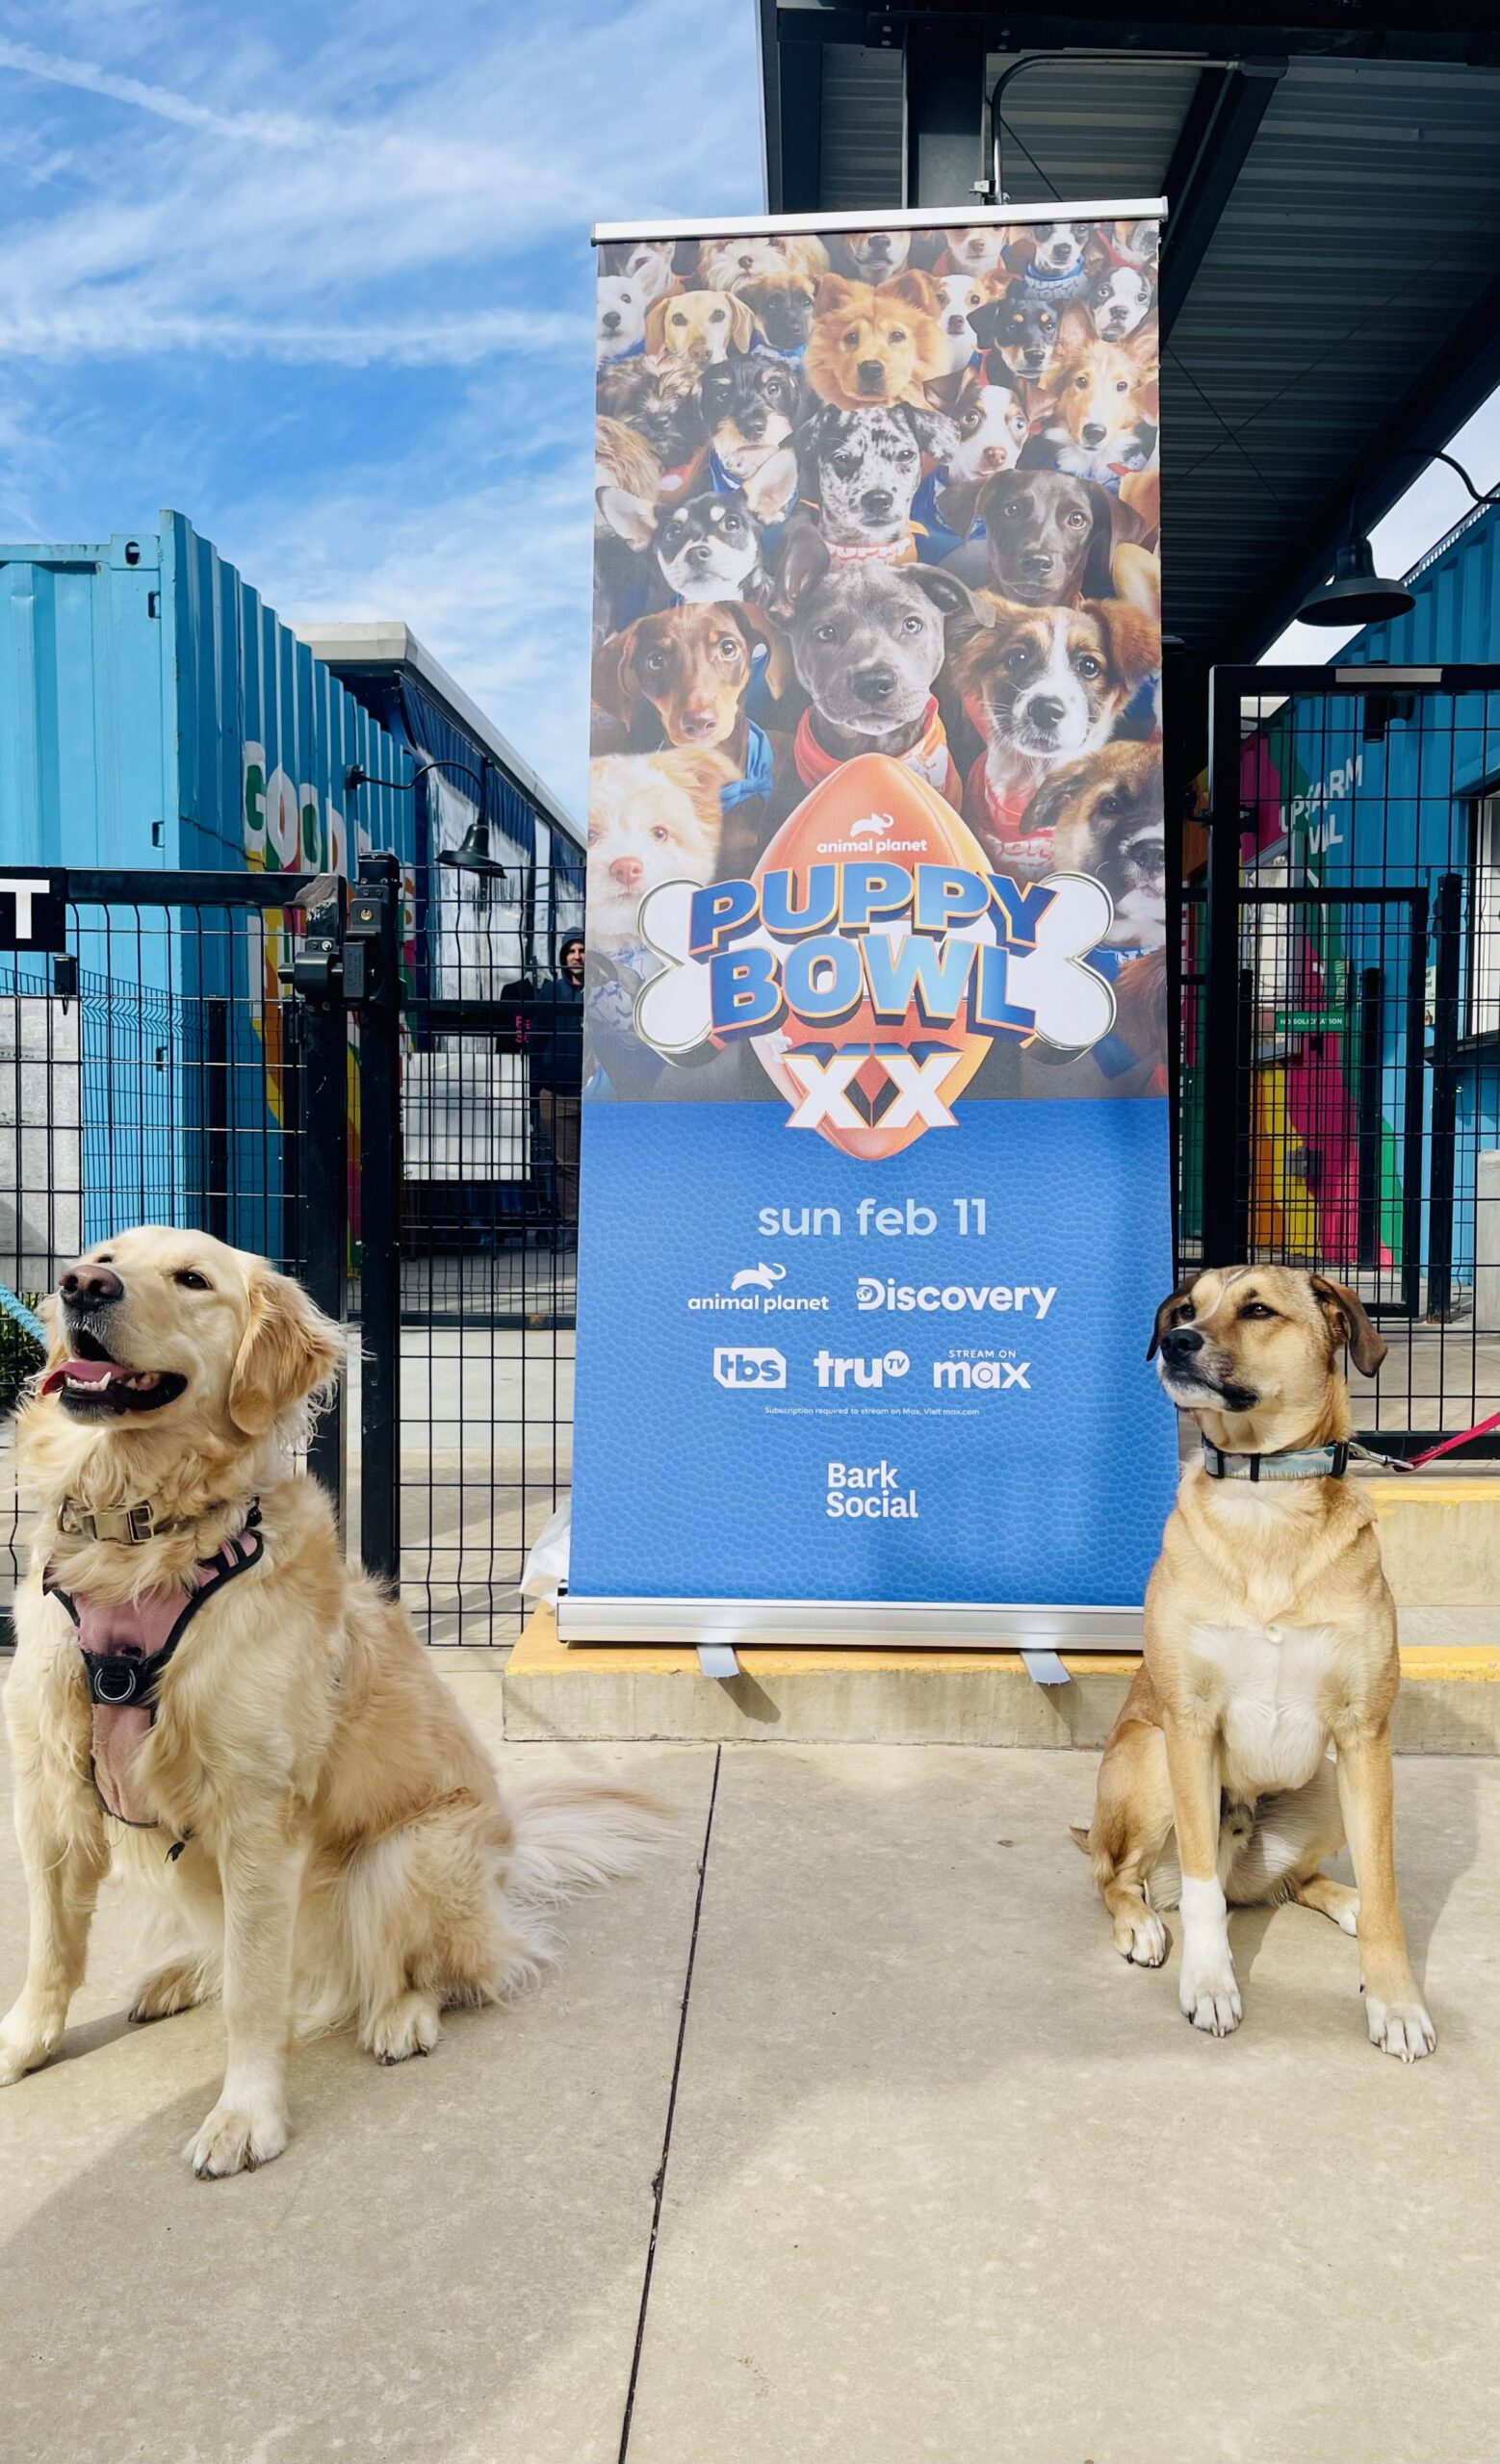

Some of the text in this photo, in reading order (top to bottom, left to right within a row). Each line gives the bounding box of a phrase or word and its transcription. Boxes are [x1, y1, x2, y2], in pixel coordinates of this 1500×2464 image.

[816, 837, 928, 856] animal planet
[688, 861, 1061, 959] PUPPY
[709, 934, 1037, 1036] BOWL
[781, 1047, 964, 1129] XX
[757, 1198, 987, 1237] sun feb 11
[687, 1293, 830, 1315] animal planet
[856, 1277, 1057, 1320] Discovery
[719, 1353, 782, 1383] tbs
[948, 1349, 1017, 1359] STREAM ON
[933, 1361, 1032, 1390] max
[764, 1406, 814, 1416] Subscription
[815, 1406, 849, 1416] required
[902, 1407, 922, 1416] Max.
[923, 1407, 942, 1416] Visit
[828, 1460, 899, 1489] Bark
[826, 1489, 919, 1519] Social
